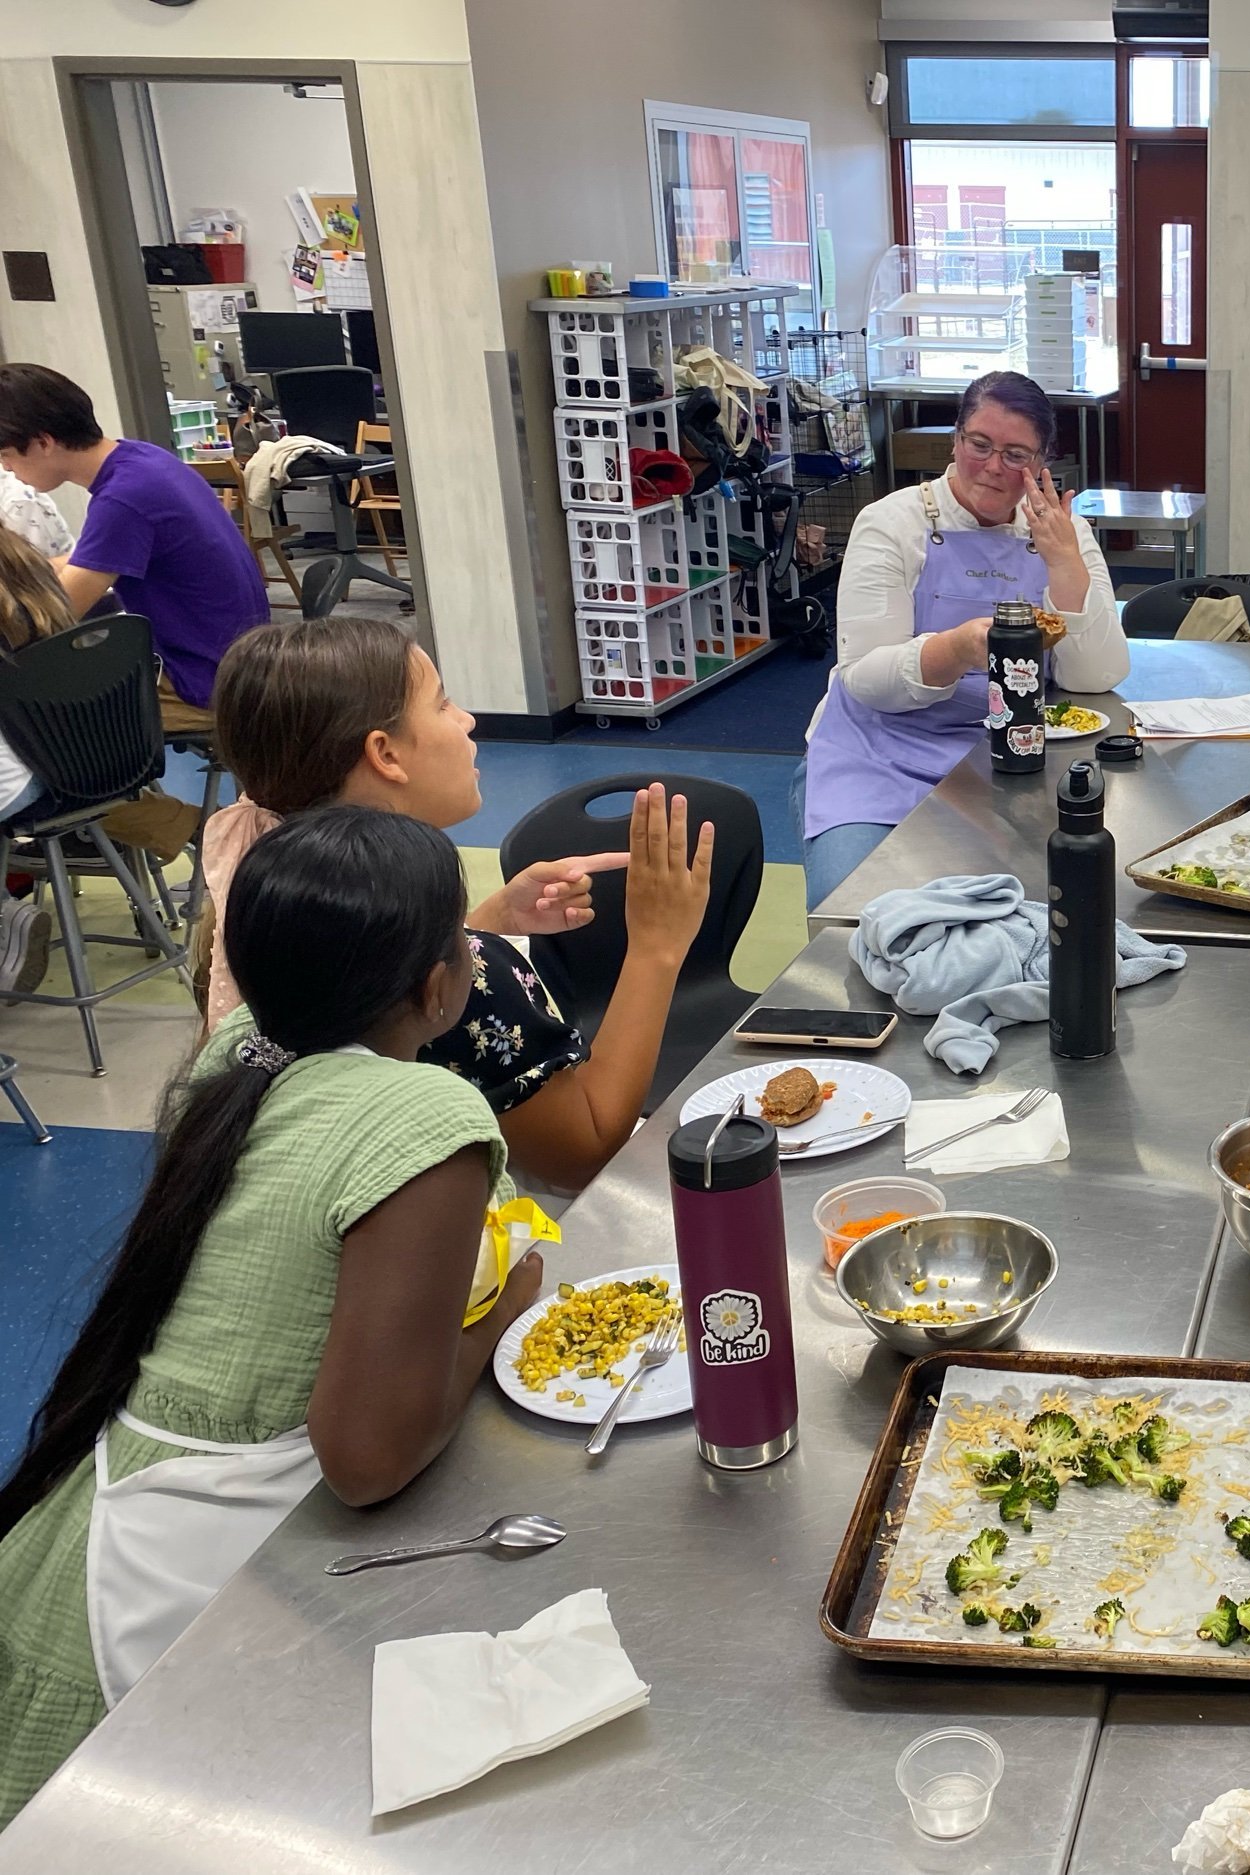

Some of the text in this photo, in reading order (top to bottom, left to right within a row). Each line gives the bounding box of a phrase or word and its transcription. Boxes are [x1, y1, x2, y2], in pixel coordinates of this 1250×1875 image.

[965, 569, 988, 578] Chef
[541, 1220, 553, 1235] 1
[703, 1336, 765, 1361] be kind
